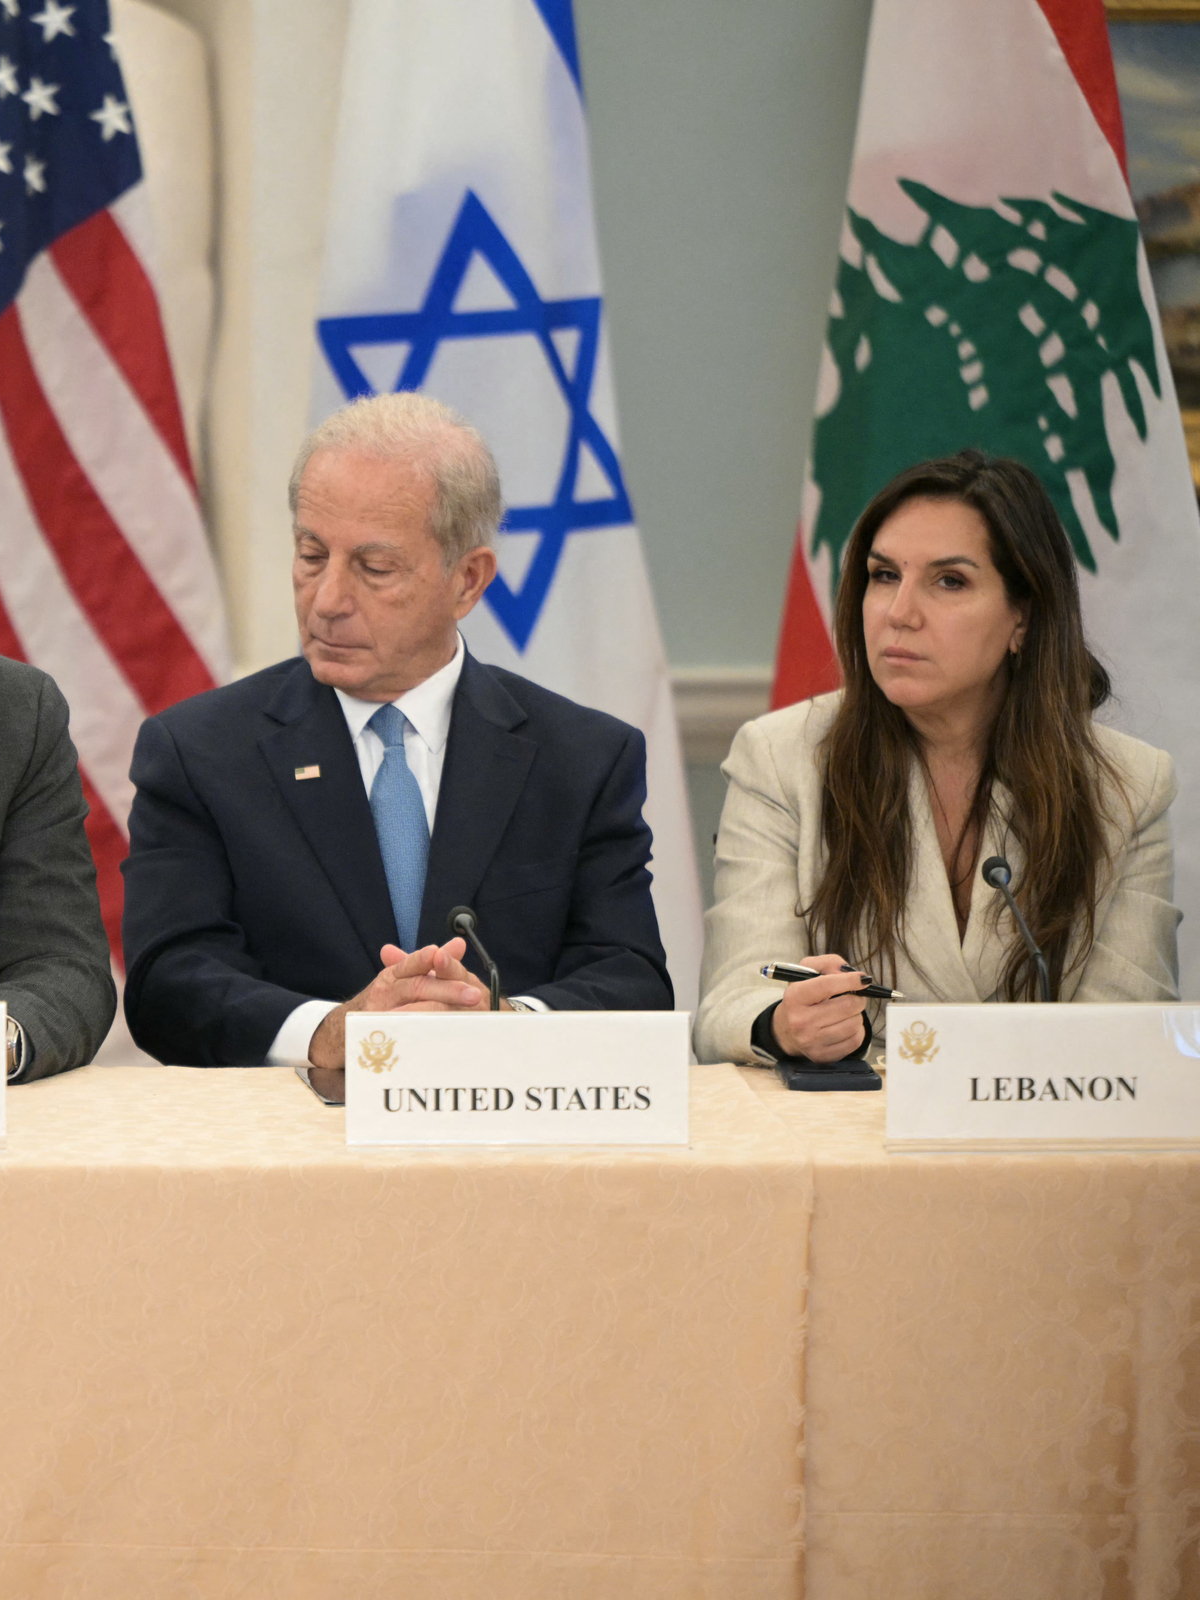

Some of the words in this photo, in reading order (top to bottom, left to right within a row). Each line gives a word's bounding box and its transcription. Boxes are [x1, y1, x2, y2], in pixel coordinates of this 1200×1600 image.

[383, 1087, 514, 1113] UNITED
[525, 1086, 651, 1111] STATES
[969, 1076, 1138, 1102] LEBANON
